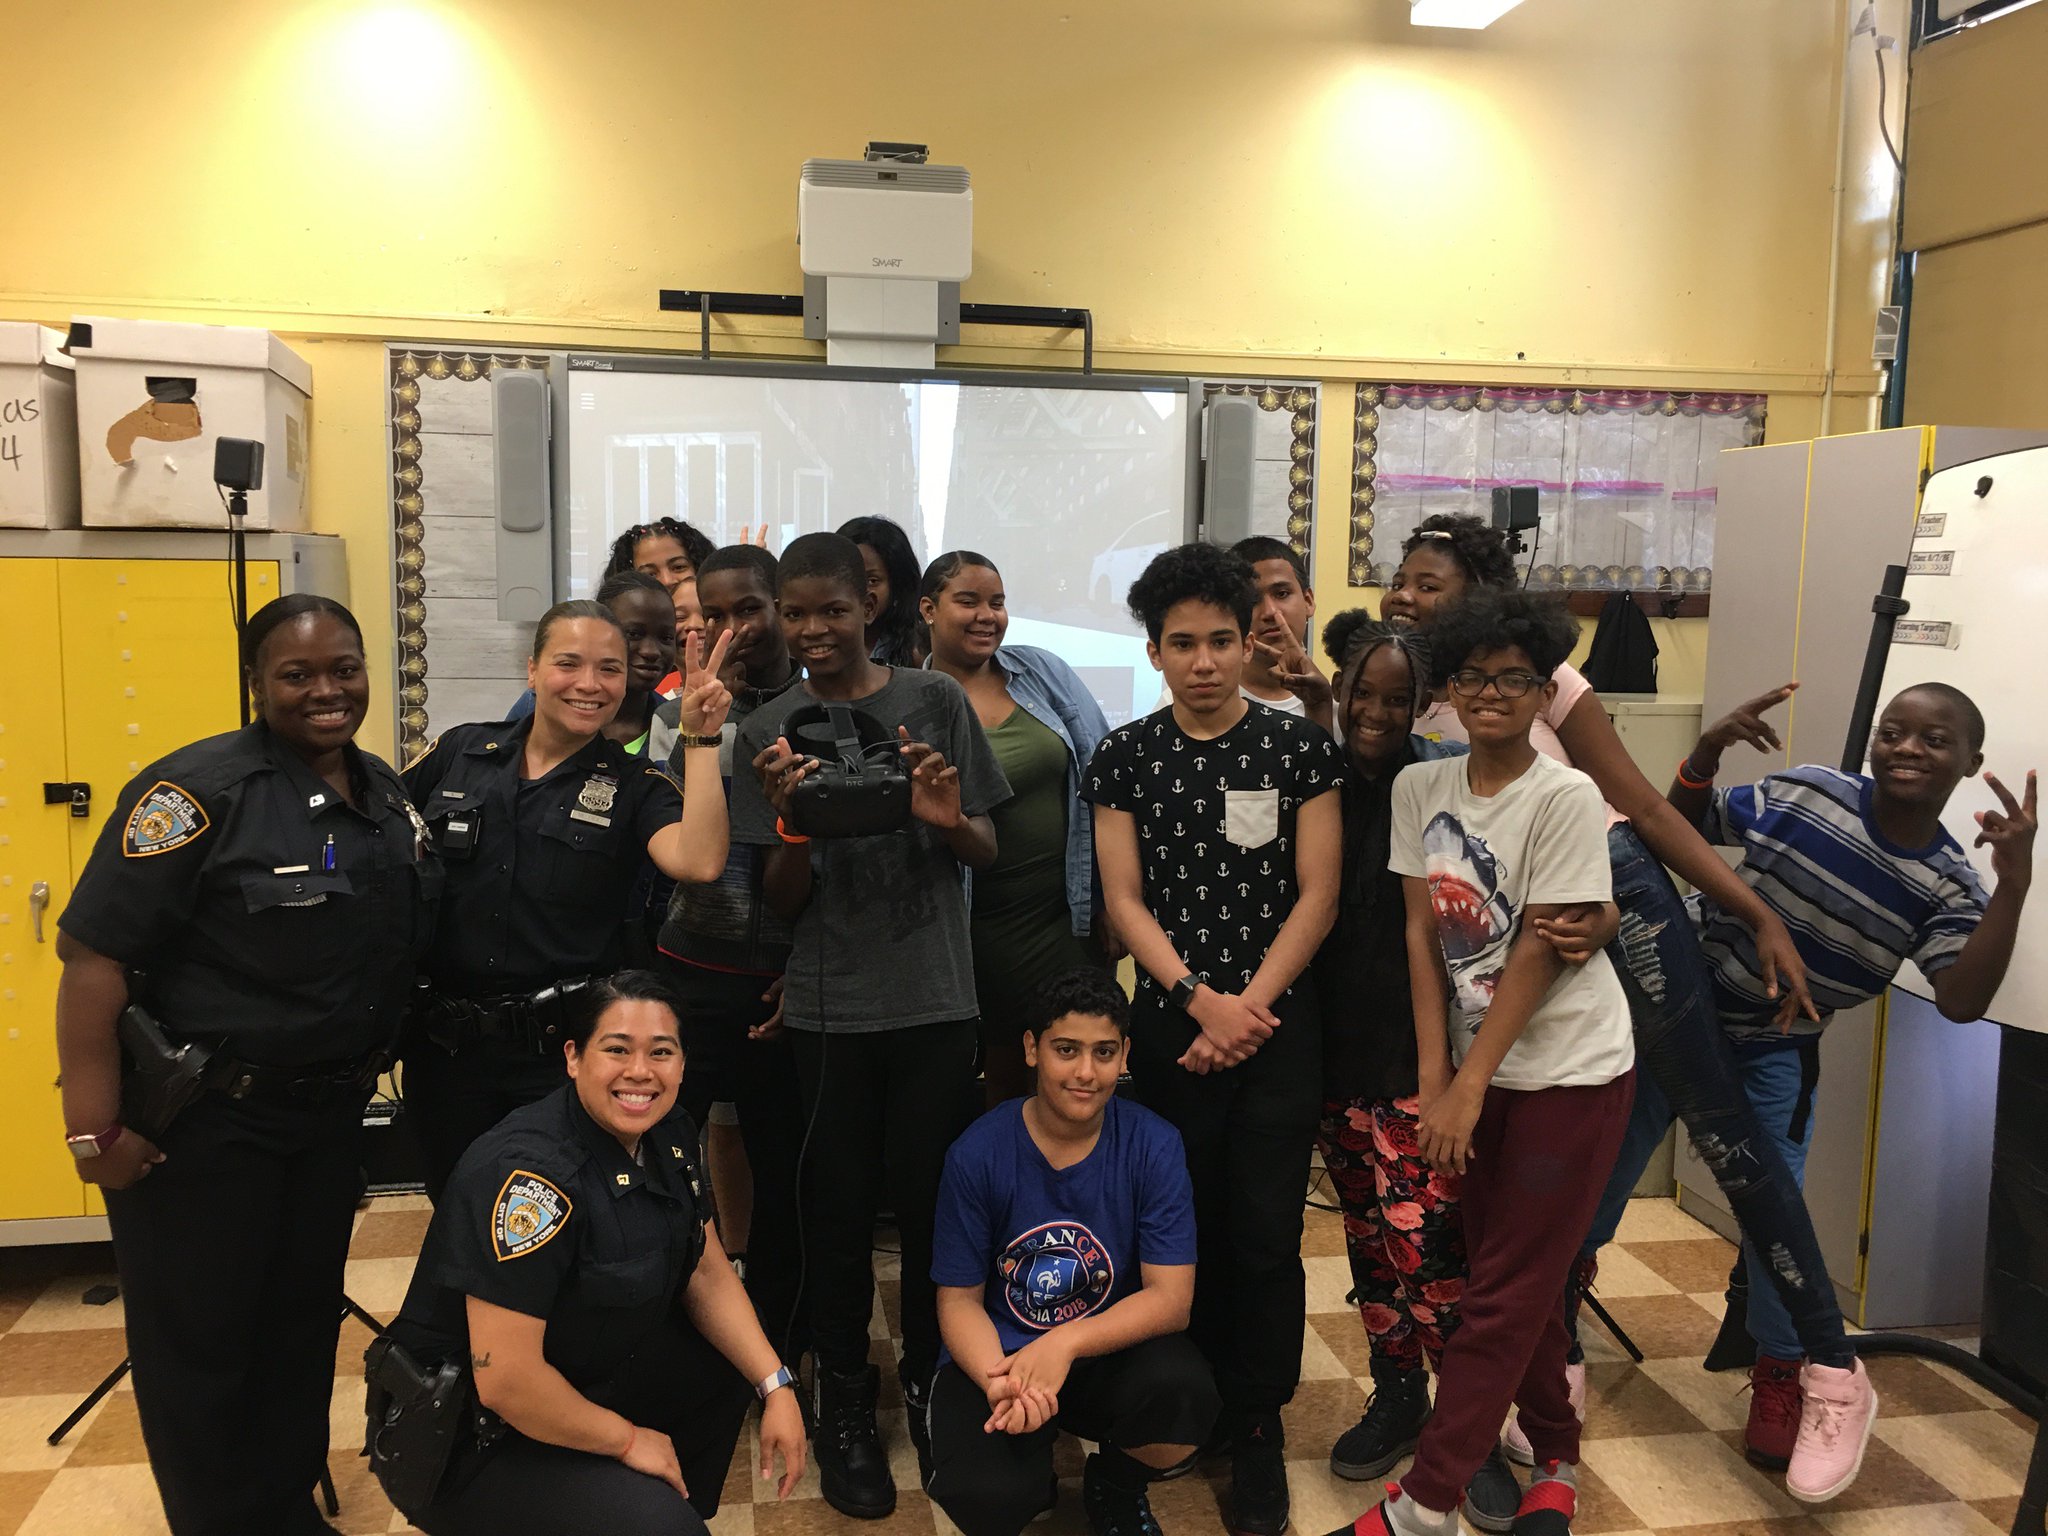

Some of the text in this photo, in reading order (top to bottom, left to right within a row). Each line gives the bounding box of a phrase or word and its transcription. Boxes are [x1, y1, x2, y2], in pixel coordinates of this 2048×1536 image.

[871, 257, 904, 268] SMART
[571, 359, 596, 367] SMART
[1, 435, 23, 472] 4
[131, 806, 144, 826] CITY
[150, 793, 197, 831] DEPARTMENT
[166, 791, 196, 816] POLICE
[138, 834, 188, 853] NEW YORK
[508, 1184, 563, 1220] DEPARTMENT
[526, 1180, 559, 1204] POLICE
[496, 1202, 507, 1241] CITY OF
[511, 1223, 557, 1254] NEW YORK
[1053, 1297, 1088, 1322] 2018
